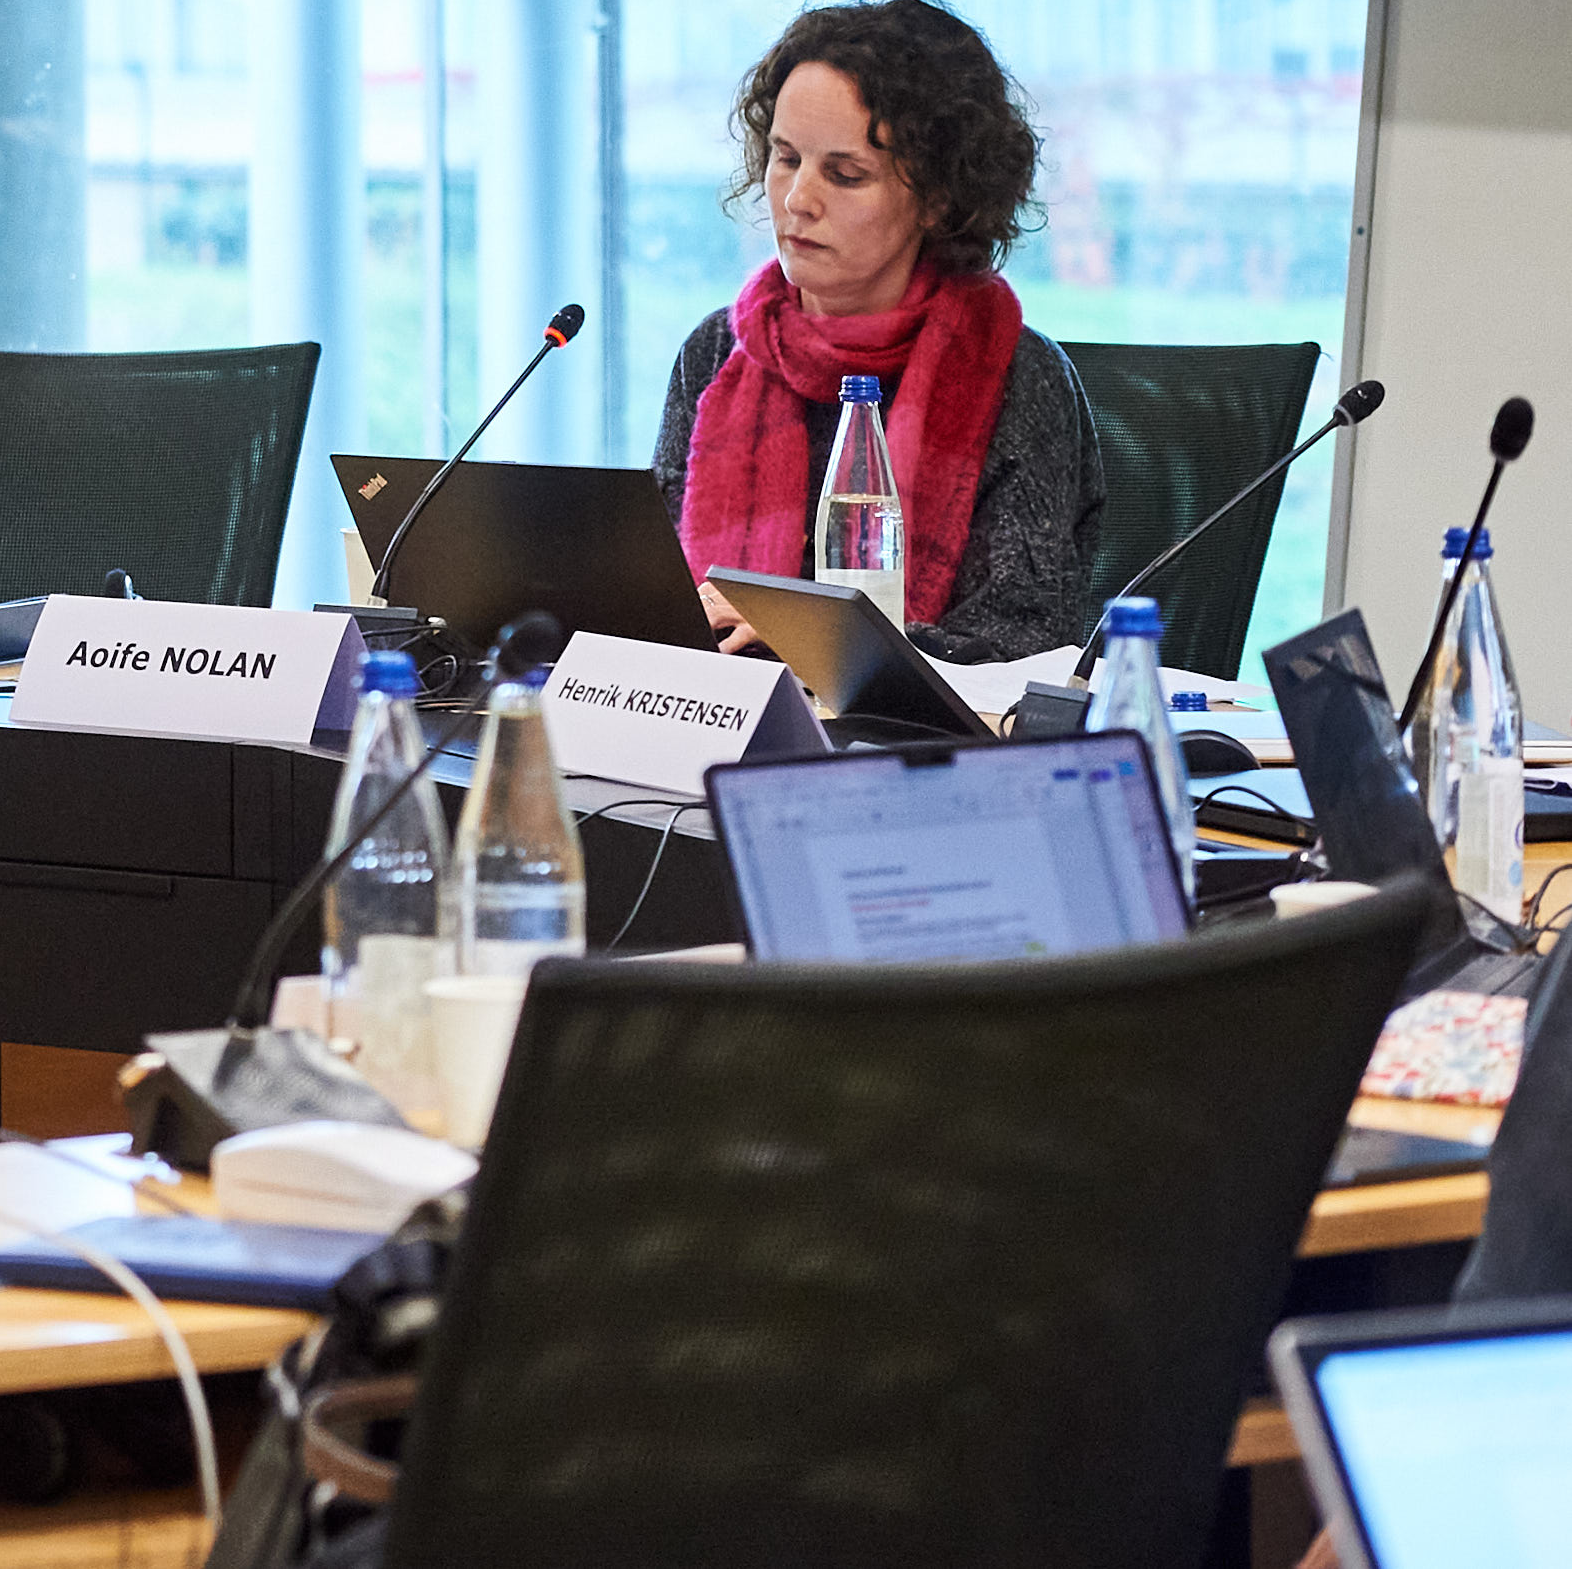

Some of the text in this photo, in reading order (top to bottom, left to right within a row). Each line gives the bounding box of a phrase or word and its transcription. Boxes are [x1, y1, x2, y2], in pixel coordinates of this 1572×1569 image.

[65, 640, 277, 680] Aoife NOLAN
[558, 677, 749, 731] Henrik KRISTENSEN
